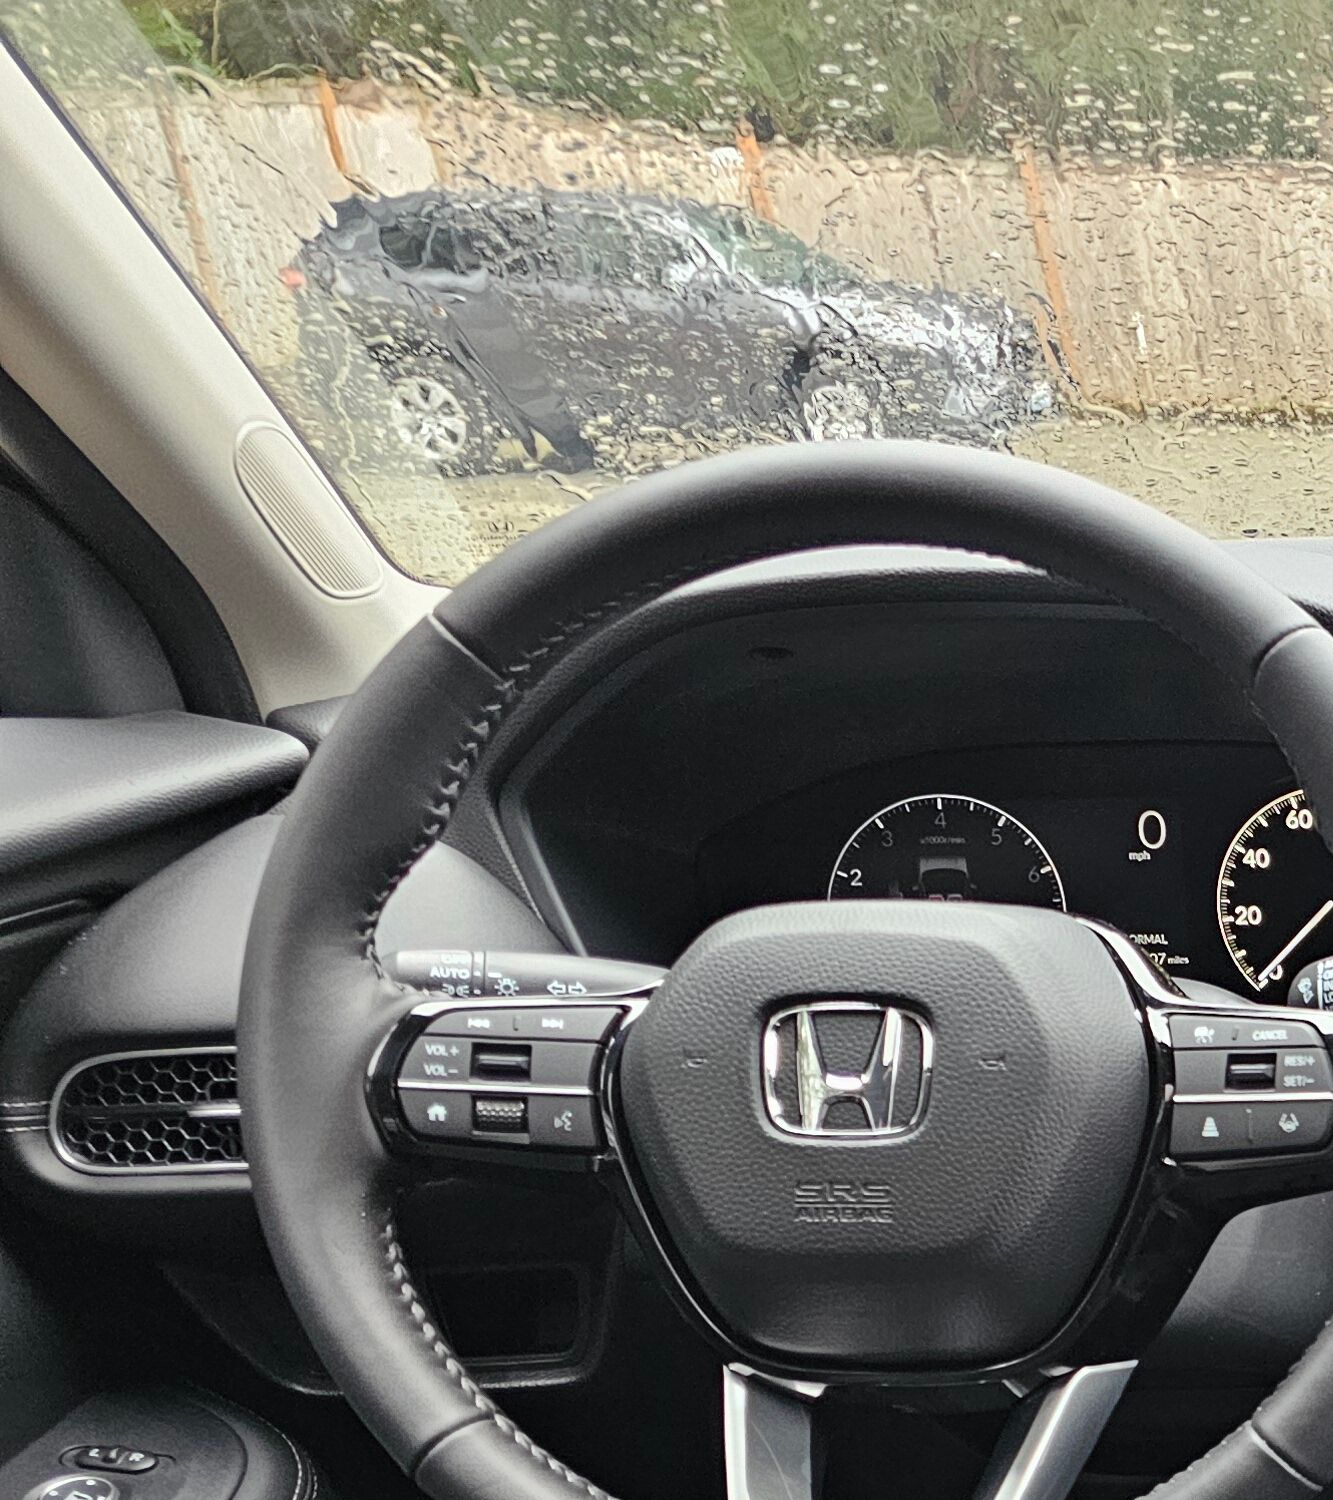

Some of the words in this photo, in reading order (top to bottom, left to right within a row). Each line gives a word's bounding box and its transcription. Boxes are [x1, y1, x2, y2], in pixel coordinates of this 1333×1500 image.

[934, 812, 947, 828] 4
[1285, 809, 1313, 830] 60
[991, 828, 1002, 846] 5
[1138, 810, 1167, 850] 0
[881, 831, 893, 847] 3
[1129, 851, 1151, 861] mph
[1242, 848, 1270, 869] 40
[850, 868, 863, 886] 2
[1028, 866, 1040, 883] 6
[1234, 905, 1262, 926] 20
[1128, 934, 1168, 945] ORMAL
[1168, 956, 1189, 965] miles
[430, 967, 470, 979] AUTO
[1252, 1029, 1288, 1041] CANCEL
[794, 1183, 895, 1202] SRS
[794, 1207, 894, 1224] AIRBAG
